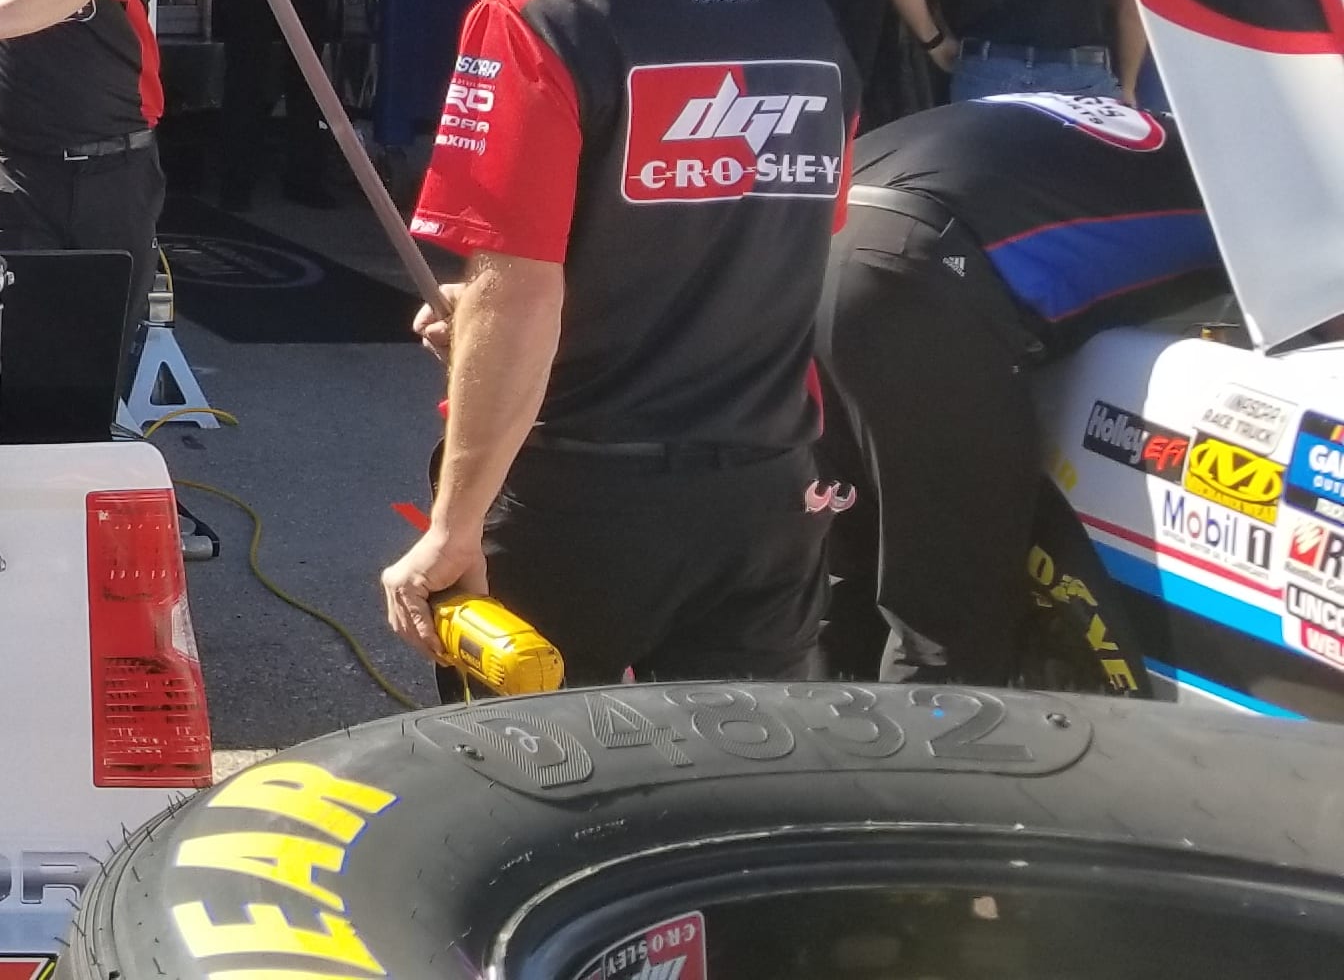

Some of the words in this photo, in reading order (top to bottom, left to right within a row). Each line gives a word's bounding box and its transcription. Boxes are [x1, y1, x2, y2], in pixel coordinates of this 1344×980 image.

[639, 154, 841, 190] CROSLEY
[1087, 404, 1143, 465] Holley
[1162, 490, 1239, 557] Mobil
[1247, 523, 1272, 571] 1
[171, 761, 398, 980] EAR
